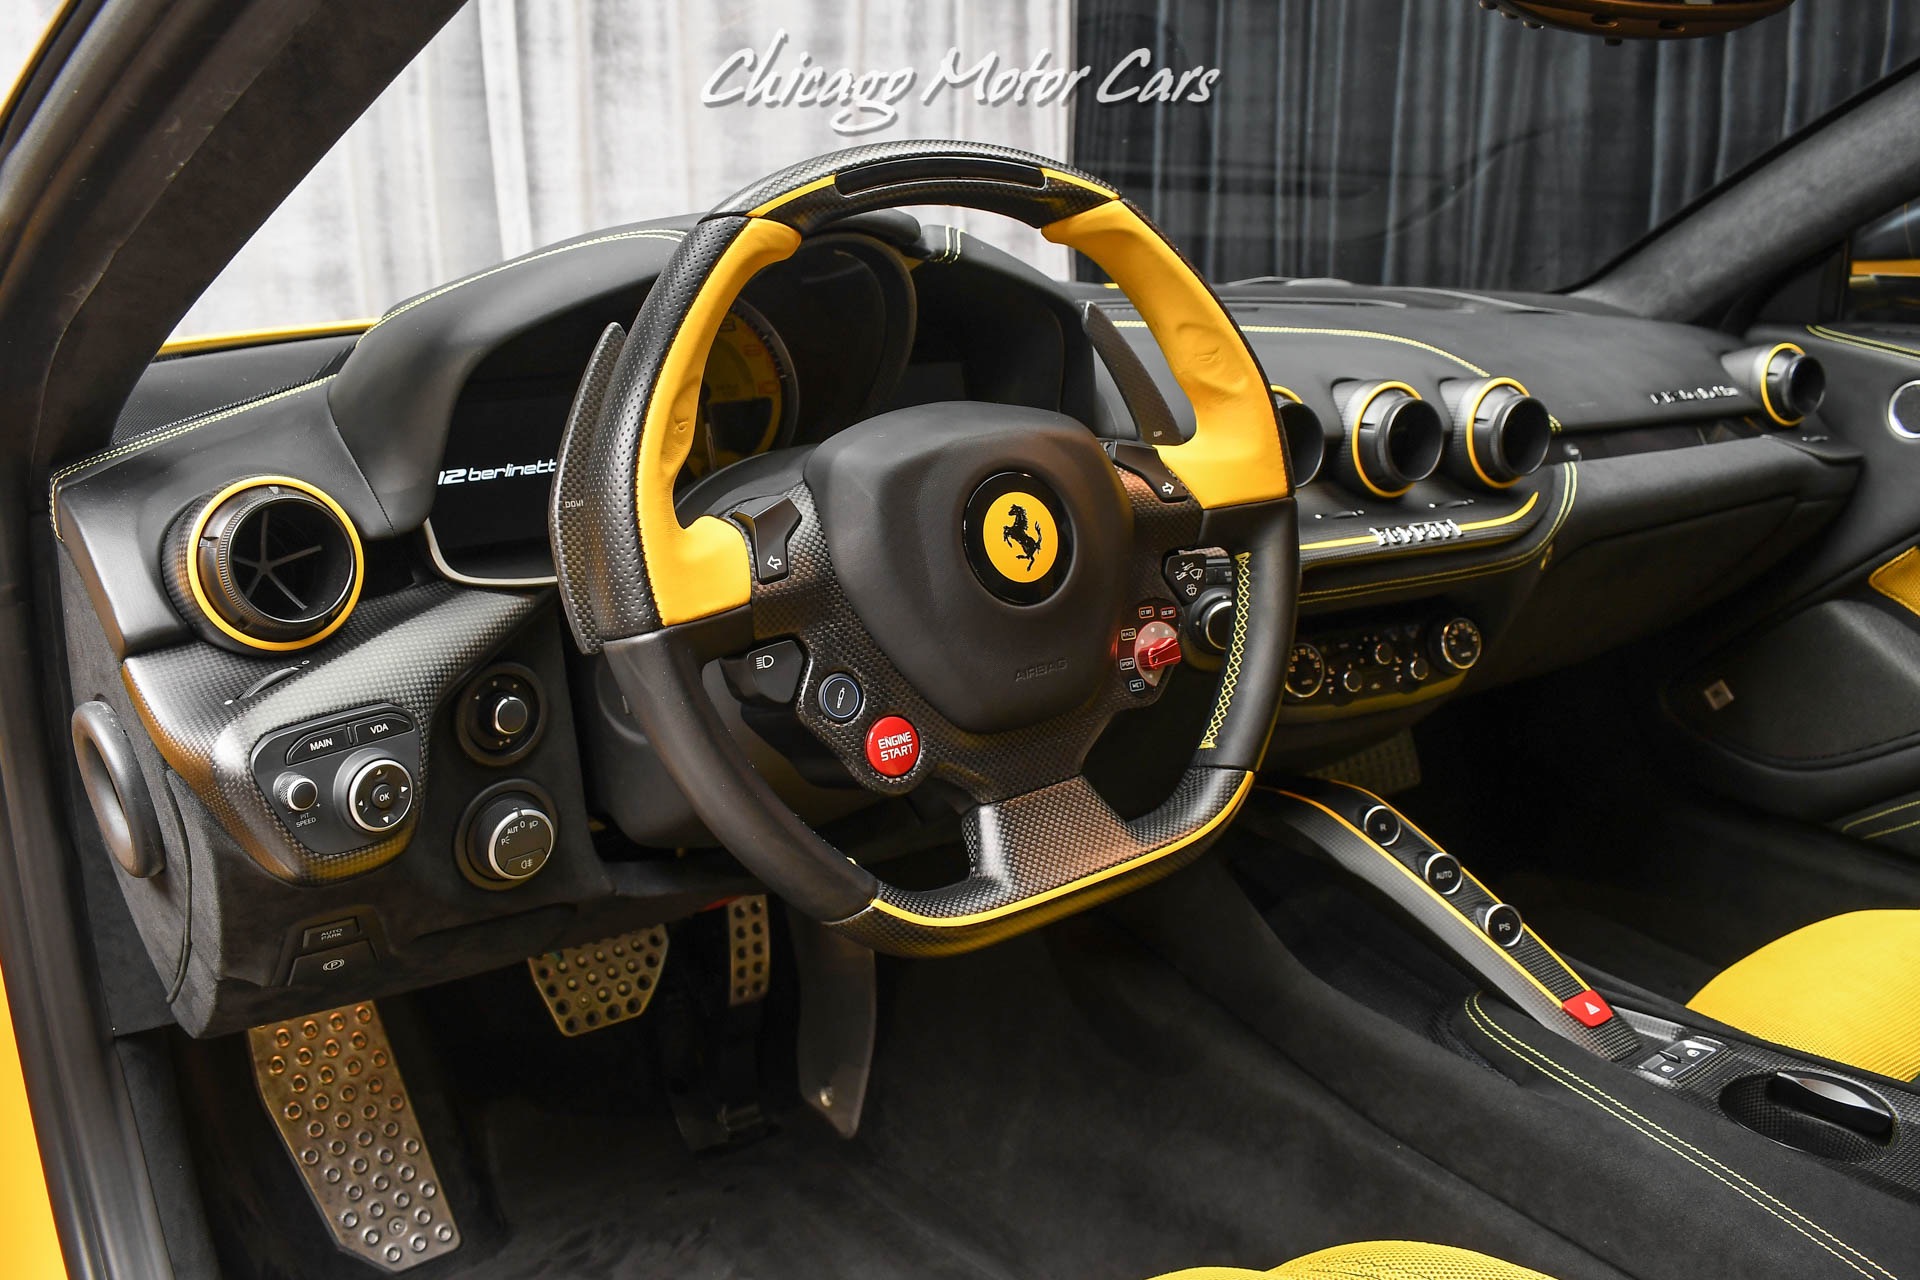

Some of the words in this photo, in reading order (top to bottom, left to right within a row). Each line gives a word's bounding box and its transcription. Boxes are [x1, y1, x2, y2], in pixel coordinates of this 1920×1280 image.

[370, 723, 389, 735] VDA
[309, 738, 333, 751] MAIN
[878, 731, 912, 749] ENGINE
[880, 743, 913, 761] START
[379, 792, 390, 802] OK
[295, 817, 317, 828] SPEED
[1436, 870, 1453, 880] AUTO
[321, 928, 343, 937] AUTO
[1498, 922, 1511, 932] PS
